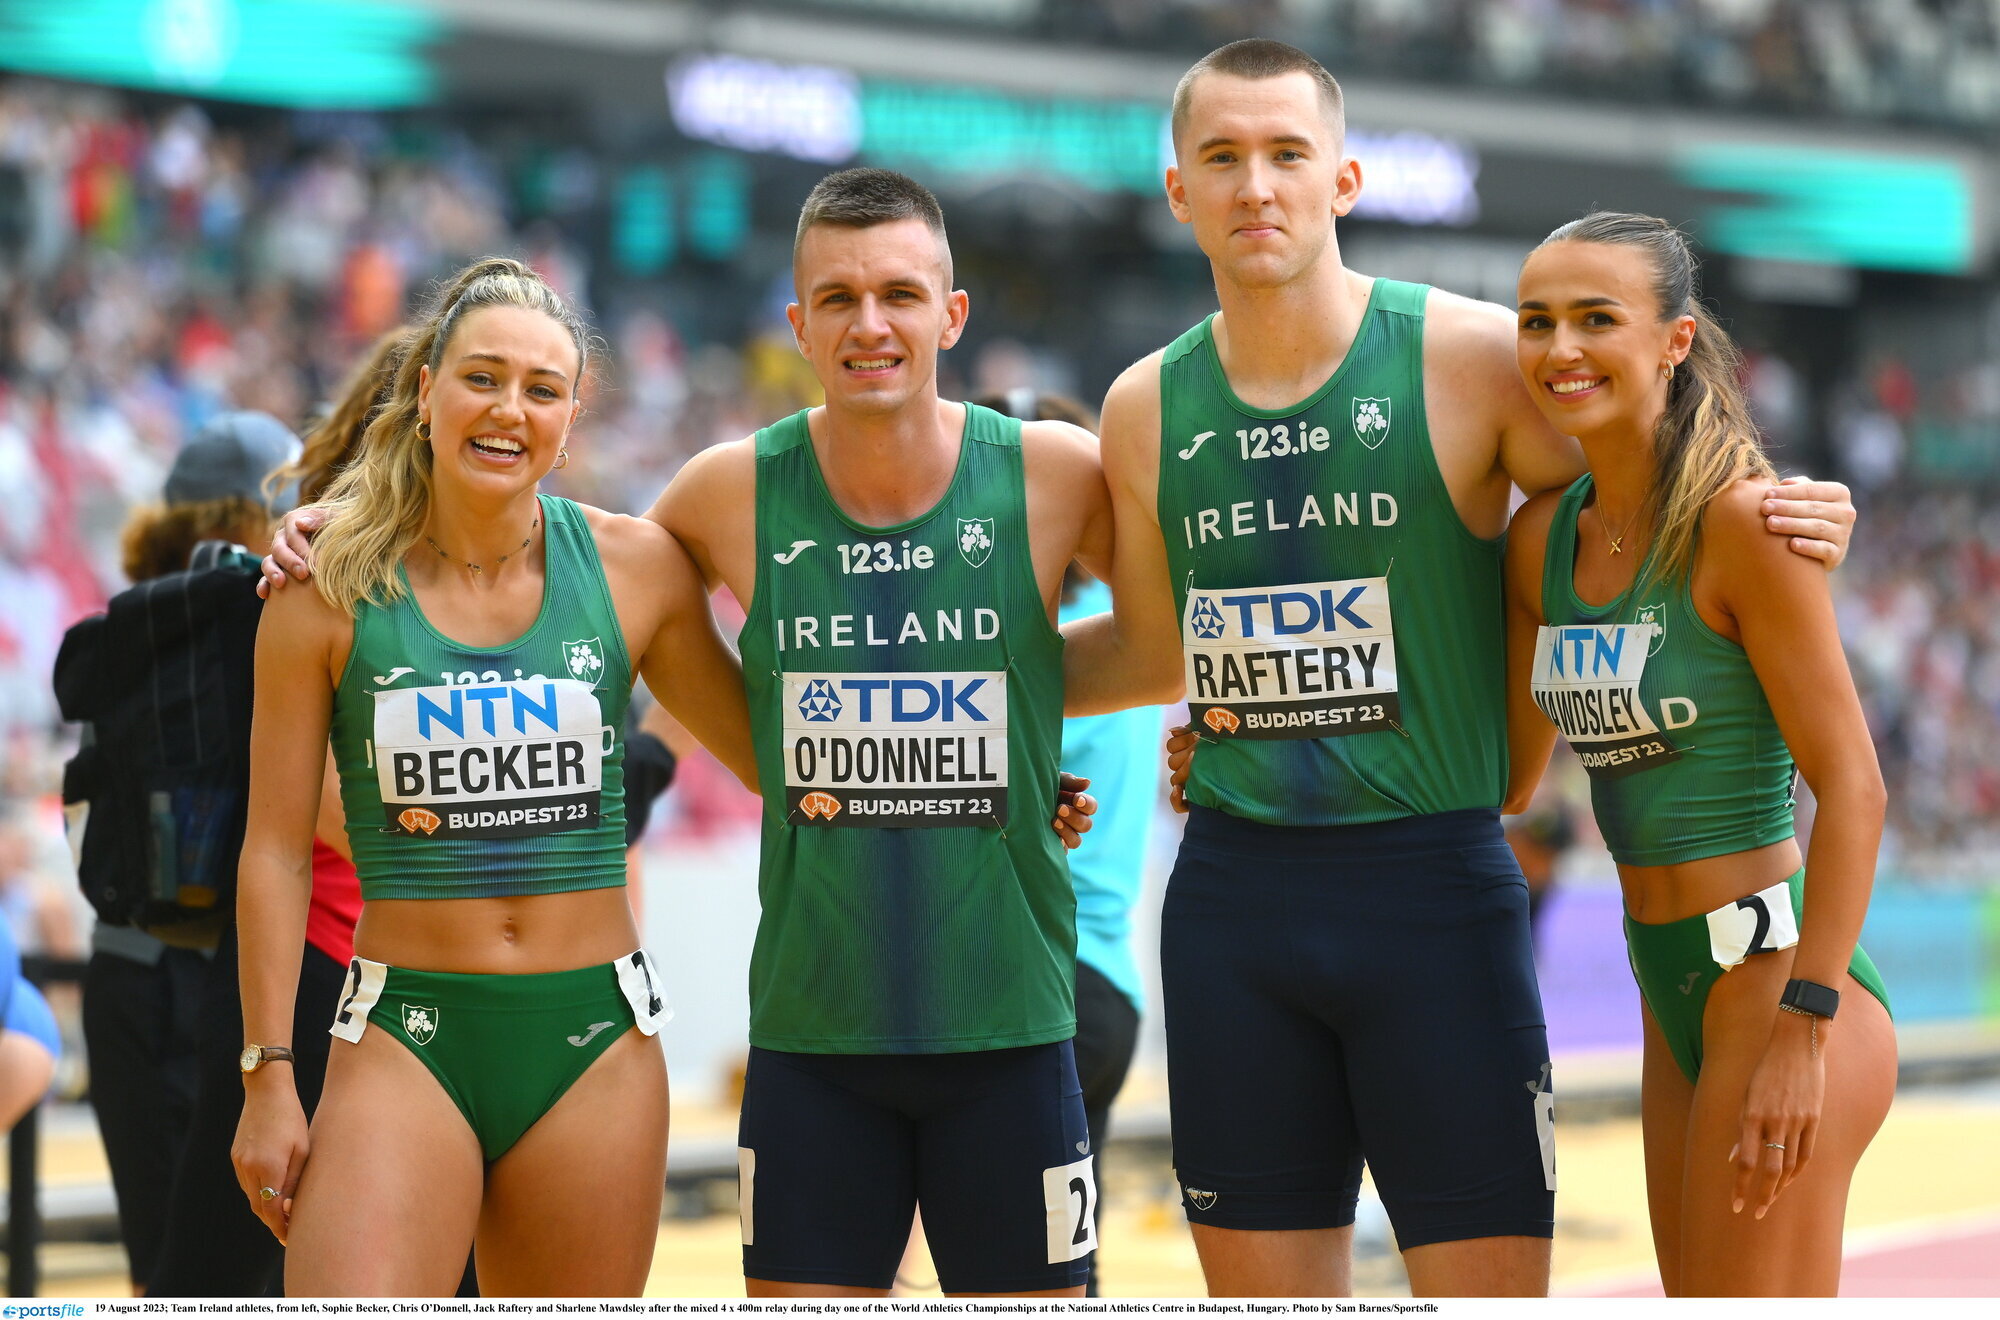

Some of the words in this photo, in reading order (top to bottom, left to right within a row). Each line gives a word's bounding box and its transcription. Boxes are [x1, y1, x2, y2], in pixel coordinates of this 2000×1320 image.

[1235, 421, 1330, 461] 123.ie
[1183, 492, 1399, 549] IRELAND
[837, 539, 934, 575] 123.ie
[777, 608, 1000, 651] IRELAND
[1222, 586, 1373, 638] TDK
[1193, 642, 1381, 698] RAFTERY
[1550, 627, 1626, 680] NTN
[417, 683, 559, 741] NTN
[841, 679, 989, 722] TDK
[1245, 707, 1355, 729] BUDAPEST
[1358, 704, 1385, 722] 23
[393, 740, 586, 797] BECKER
[795, 736, 997, 783] O'DONNELL
[1578, 746, 1641, 768] UDAPEST
[1640, 741, 1665, 756] 23
[448, 806, 564, 829] BUDAPEST
[566, 803, 588, 821] 23
[849, 799, 966, 815] BUDAPEST
[968, 798, 992, 814] 23
[1735, 894, 1778, 958] 2
[1068, 1177, 1089, 1246] 2
